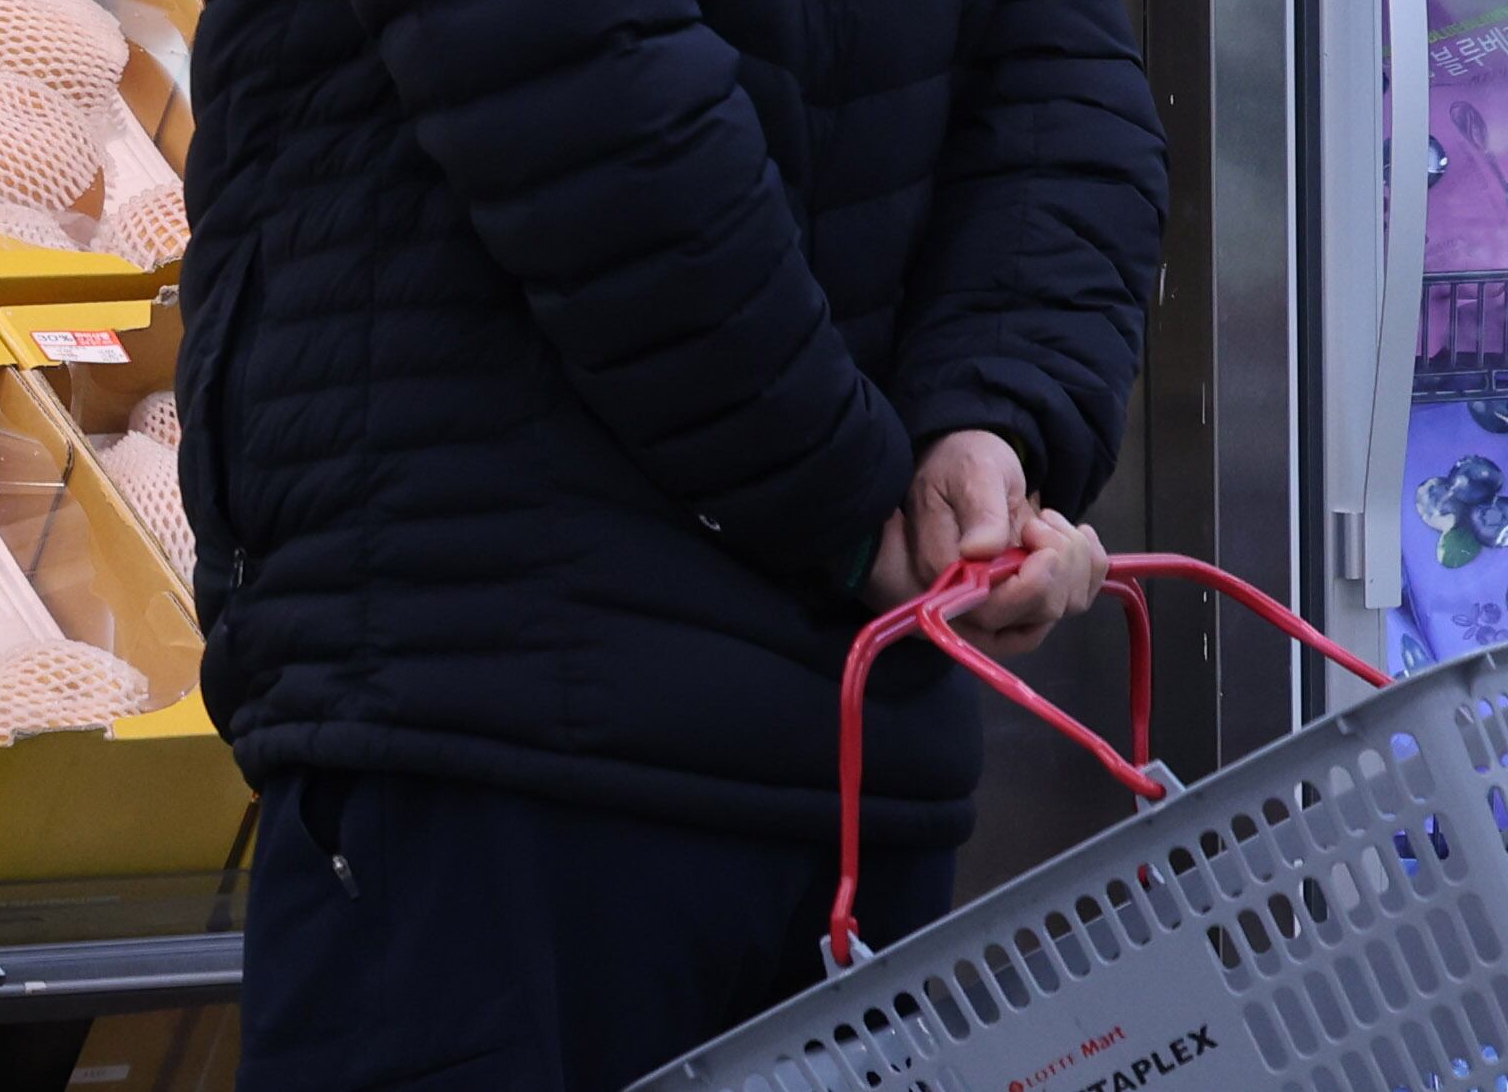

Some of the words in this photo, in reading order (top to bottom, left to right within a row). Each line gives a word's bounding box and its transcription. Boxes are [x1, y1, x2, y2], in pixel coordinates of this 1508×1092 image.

[1430, 25, 1508, 77] 블루베
[1079, 1023, 1218, 1092] TAPLEX
[1081, 1024, 1127, 1058] Mart
